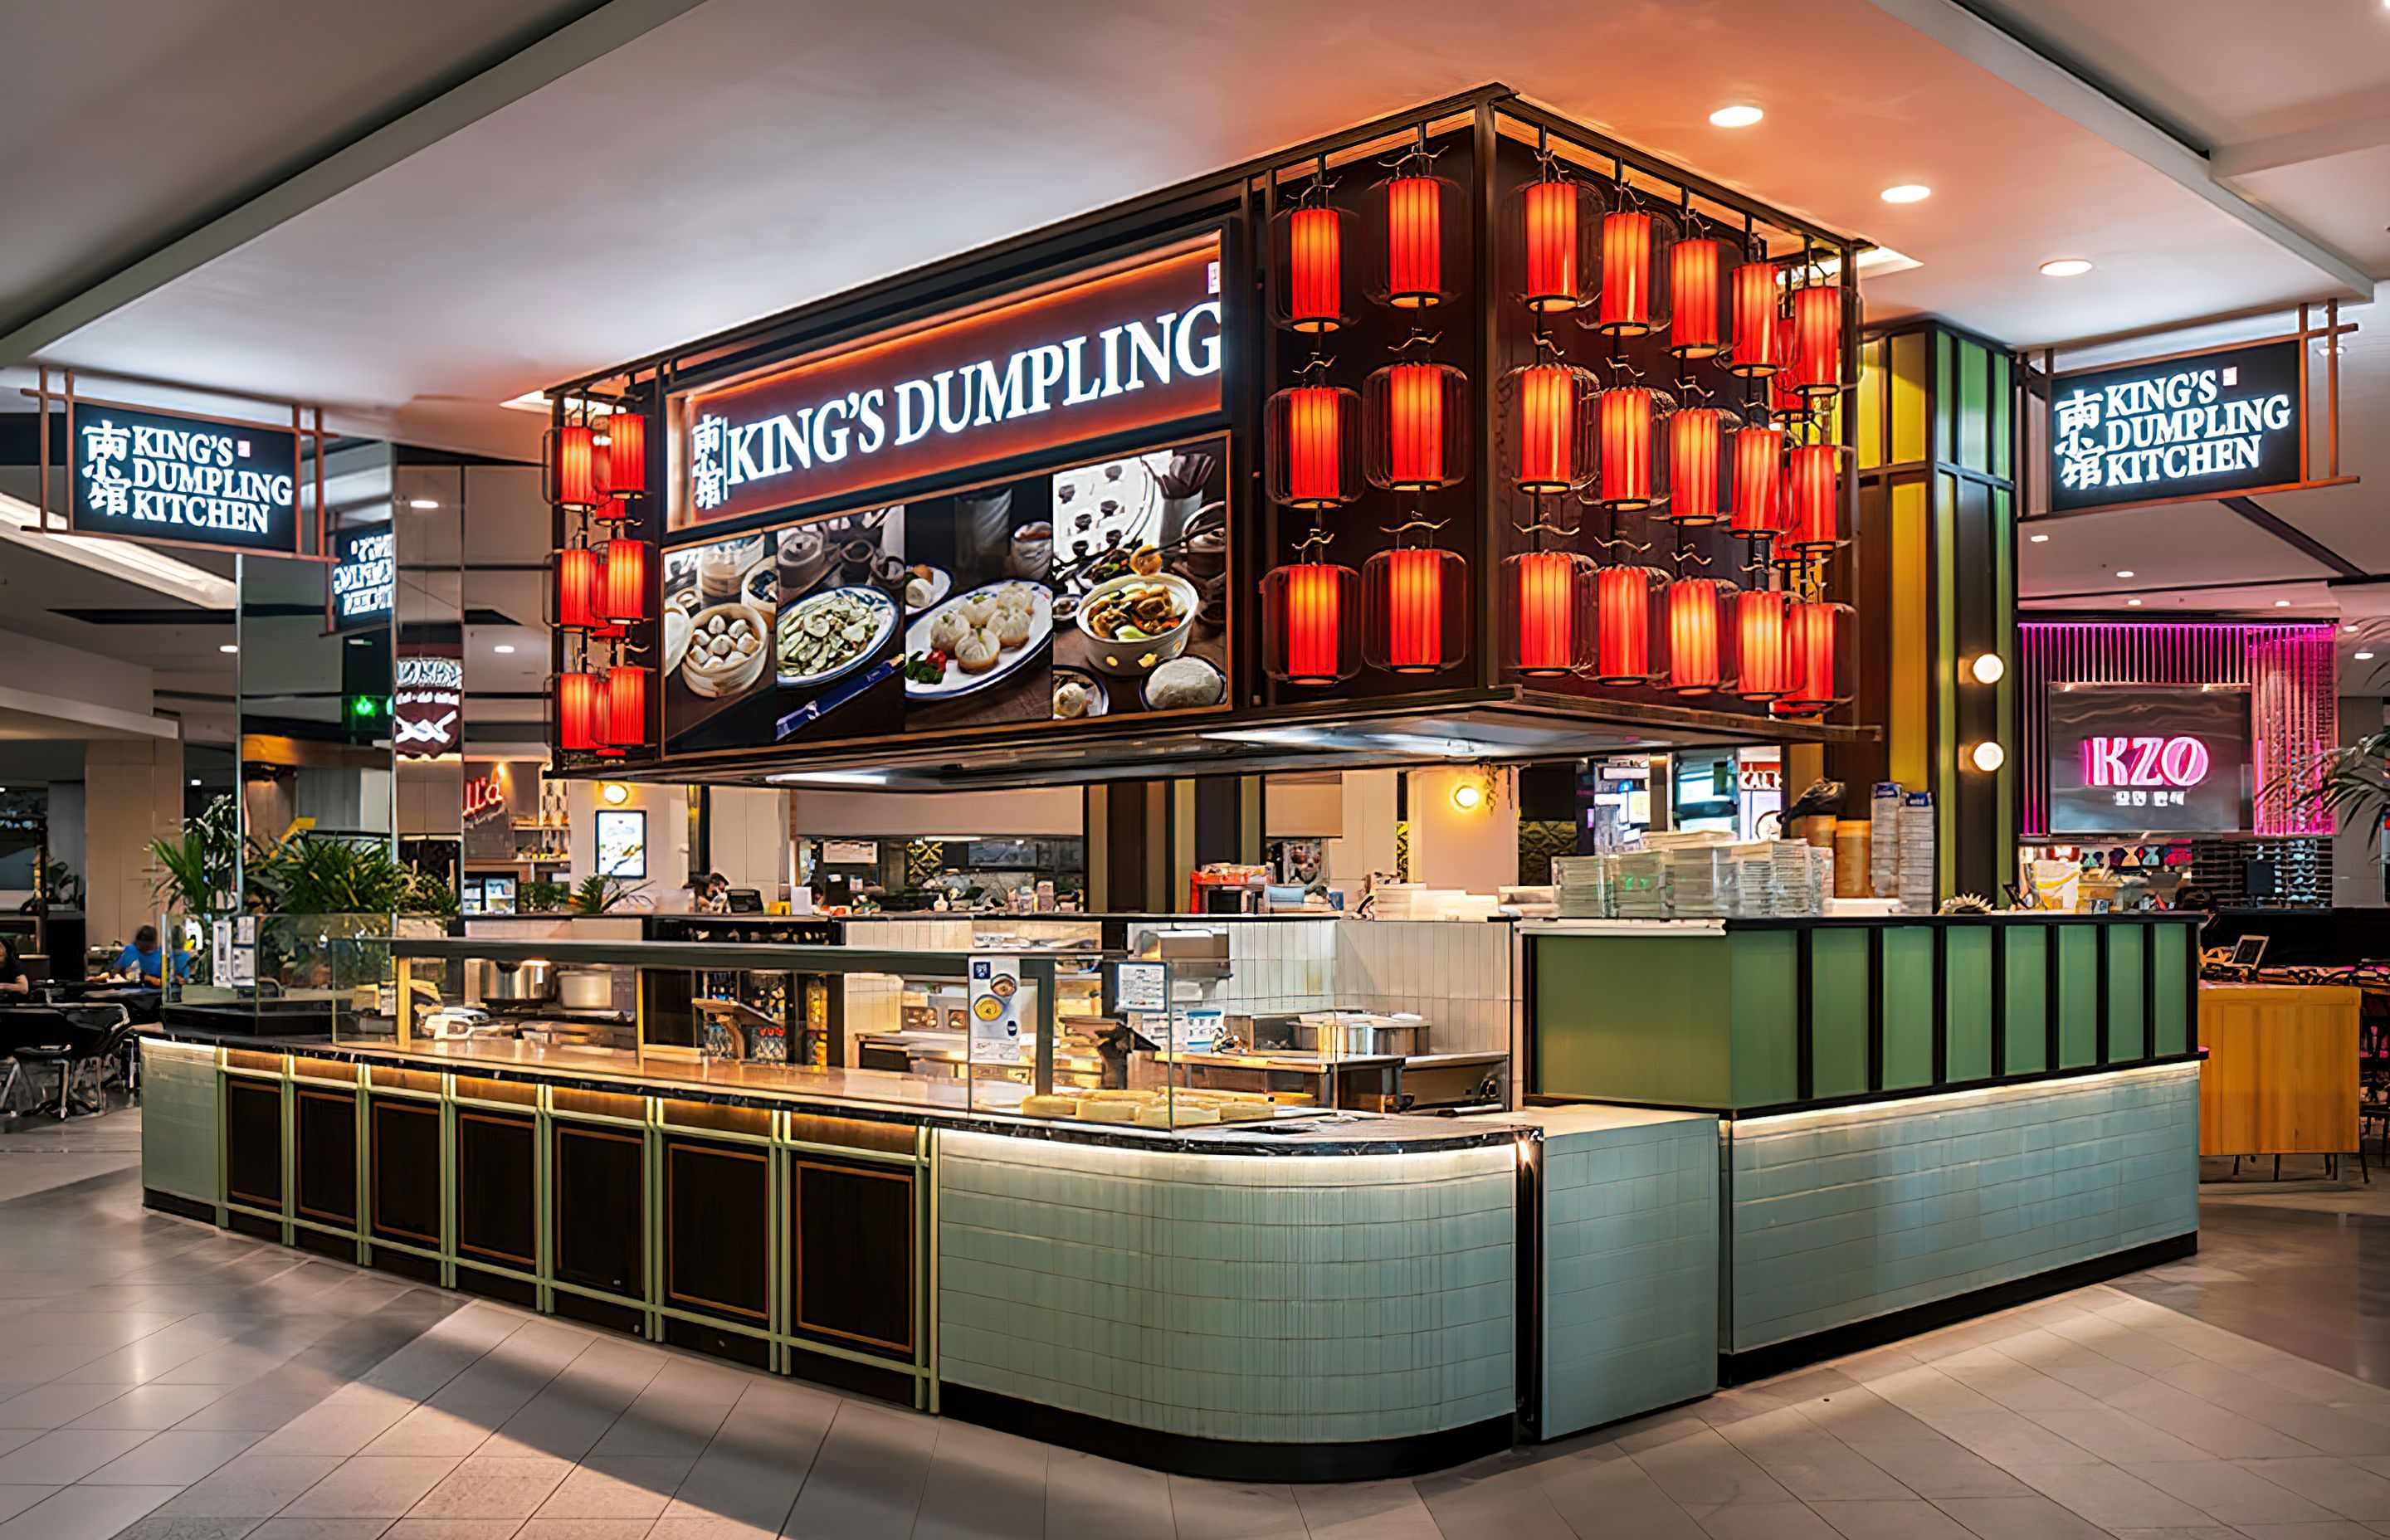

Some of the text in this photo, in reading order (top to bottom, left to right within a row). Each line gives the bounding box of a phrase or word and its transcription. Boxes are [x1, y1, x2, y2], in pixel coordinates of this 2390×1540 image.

[726, 301, 1221, 486] KING'S DUMPLING
[2105, 368, 2217, 419] KING'S
[132, 425, 234, 468] KING'S
[2105, 393, 2291, 452] DUMPLING
[133, 457, 293, 506] DUMPLING
[2105, 434, 2262, 487] KITCHEN
[132, 489, 271, 534] KITCHEN
[2088, 736, 2209, 787] KZO
